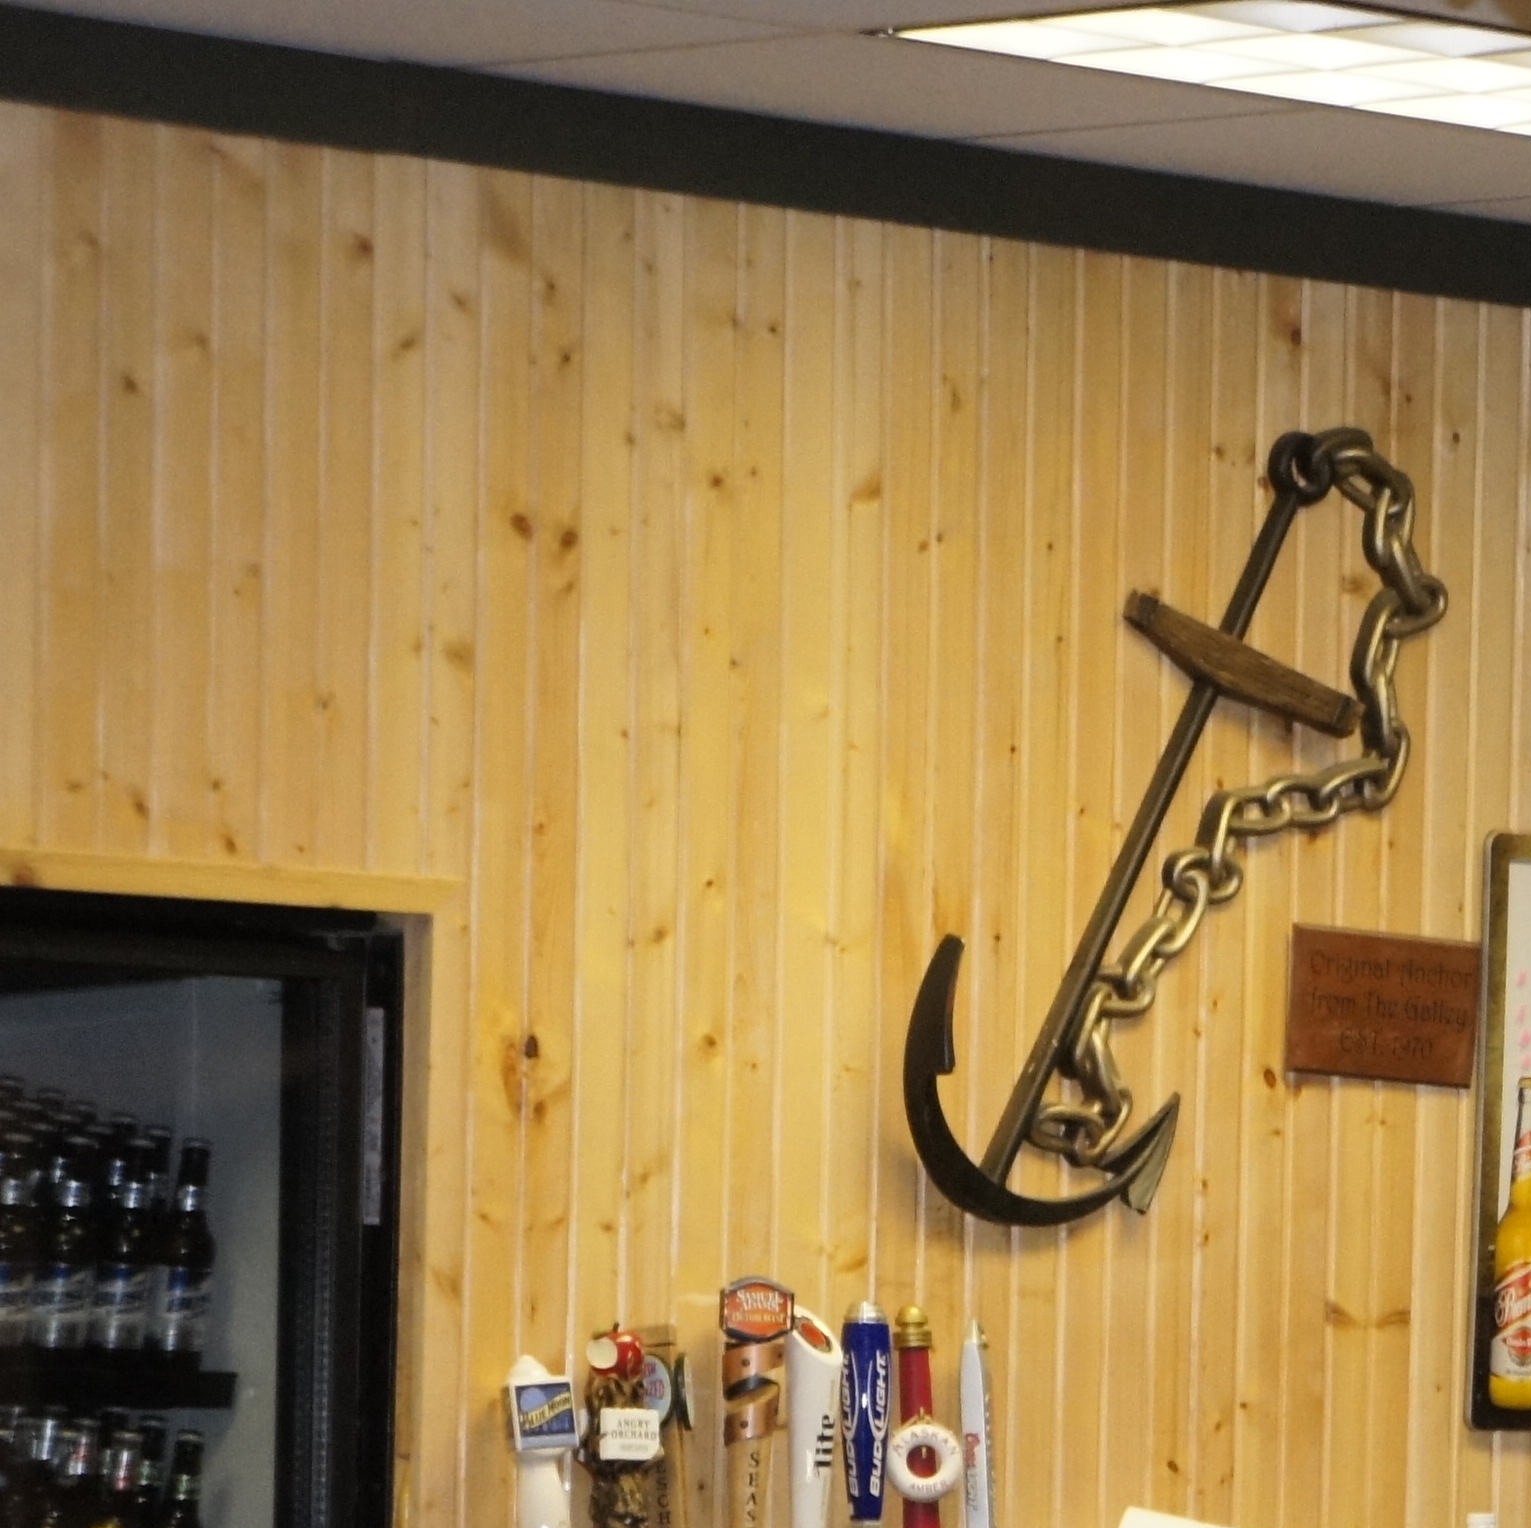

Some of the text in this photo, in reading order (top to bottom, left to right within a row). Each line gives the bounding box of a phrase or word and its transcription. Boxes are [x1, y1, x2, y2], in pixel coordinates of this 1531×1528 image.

[1310, 950, 1473, 988] Original Anchor
[1365, 991, 1399, 1020] The
[1404, 996, 1468, 1034] Galley
[611, 1430, 658, 1441] ORCHARD
[617, 1419, 650, 1429] ANGRY
[869, 1349, 889, 1498] BUD LIGHT
[910, 1478, 950, 1494] AMBER
